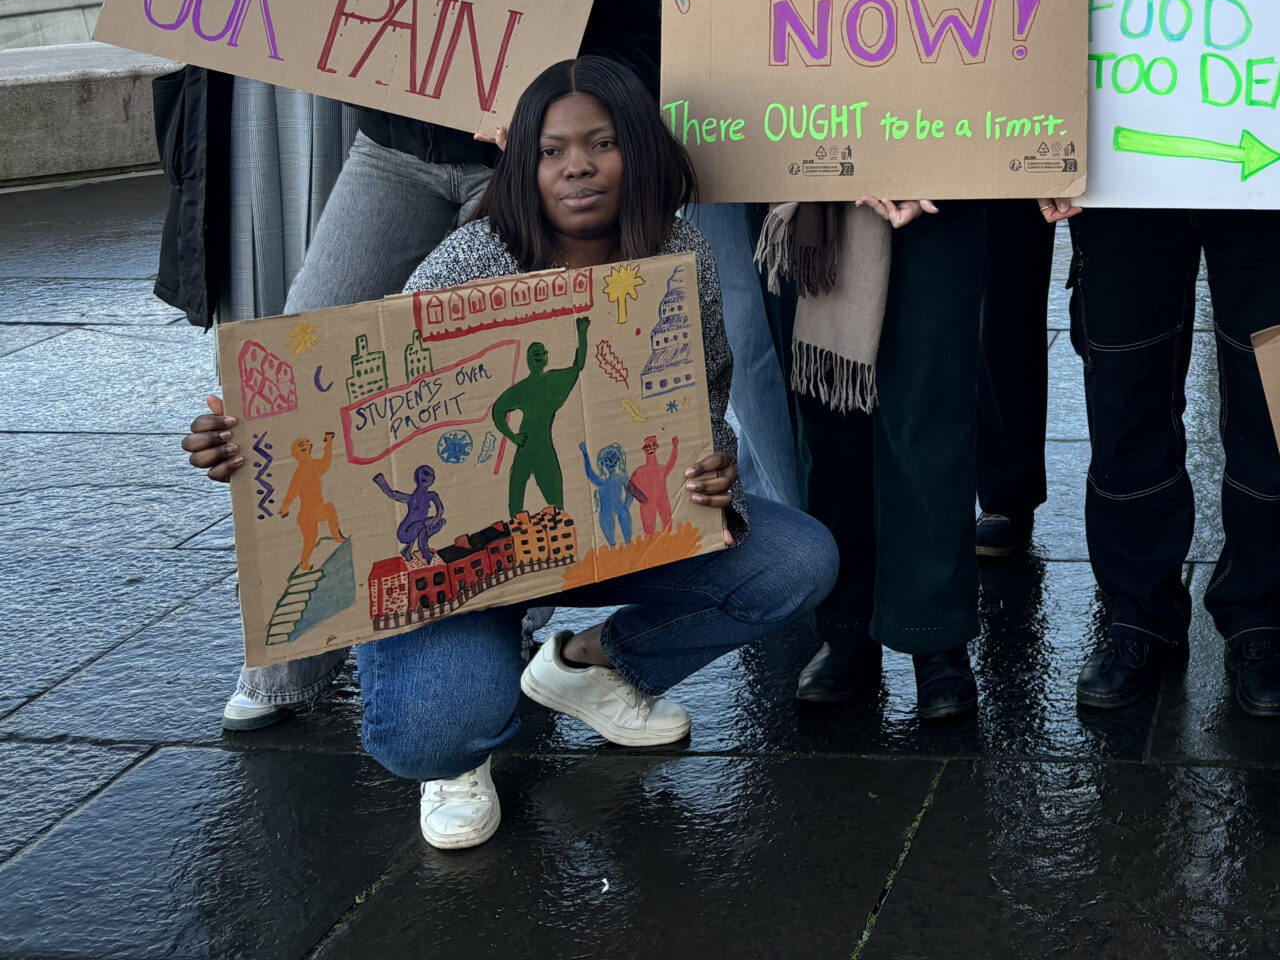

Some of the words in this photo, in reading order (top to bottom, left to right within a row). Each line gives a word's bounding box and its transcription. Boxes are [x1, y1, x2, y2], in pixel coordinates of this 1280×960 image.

[1089, 52, 1178, 95] TOO
[662, 100, 746, 146] There
[764, 102, 869, 141] OUGHT
[881, 112, 908, 141] to
[916, 110, 944, 139] be
[955, 119, 972, 138] a
[986, 111, 1068, 140] limit.
[356, 378, 442, 431] STUDENTS
[456, 364, 492, 386] OVER
[390, 392, 465, 440] PROFIT
